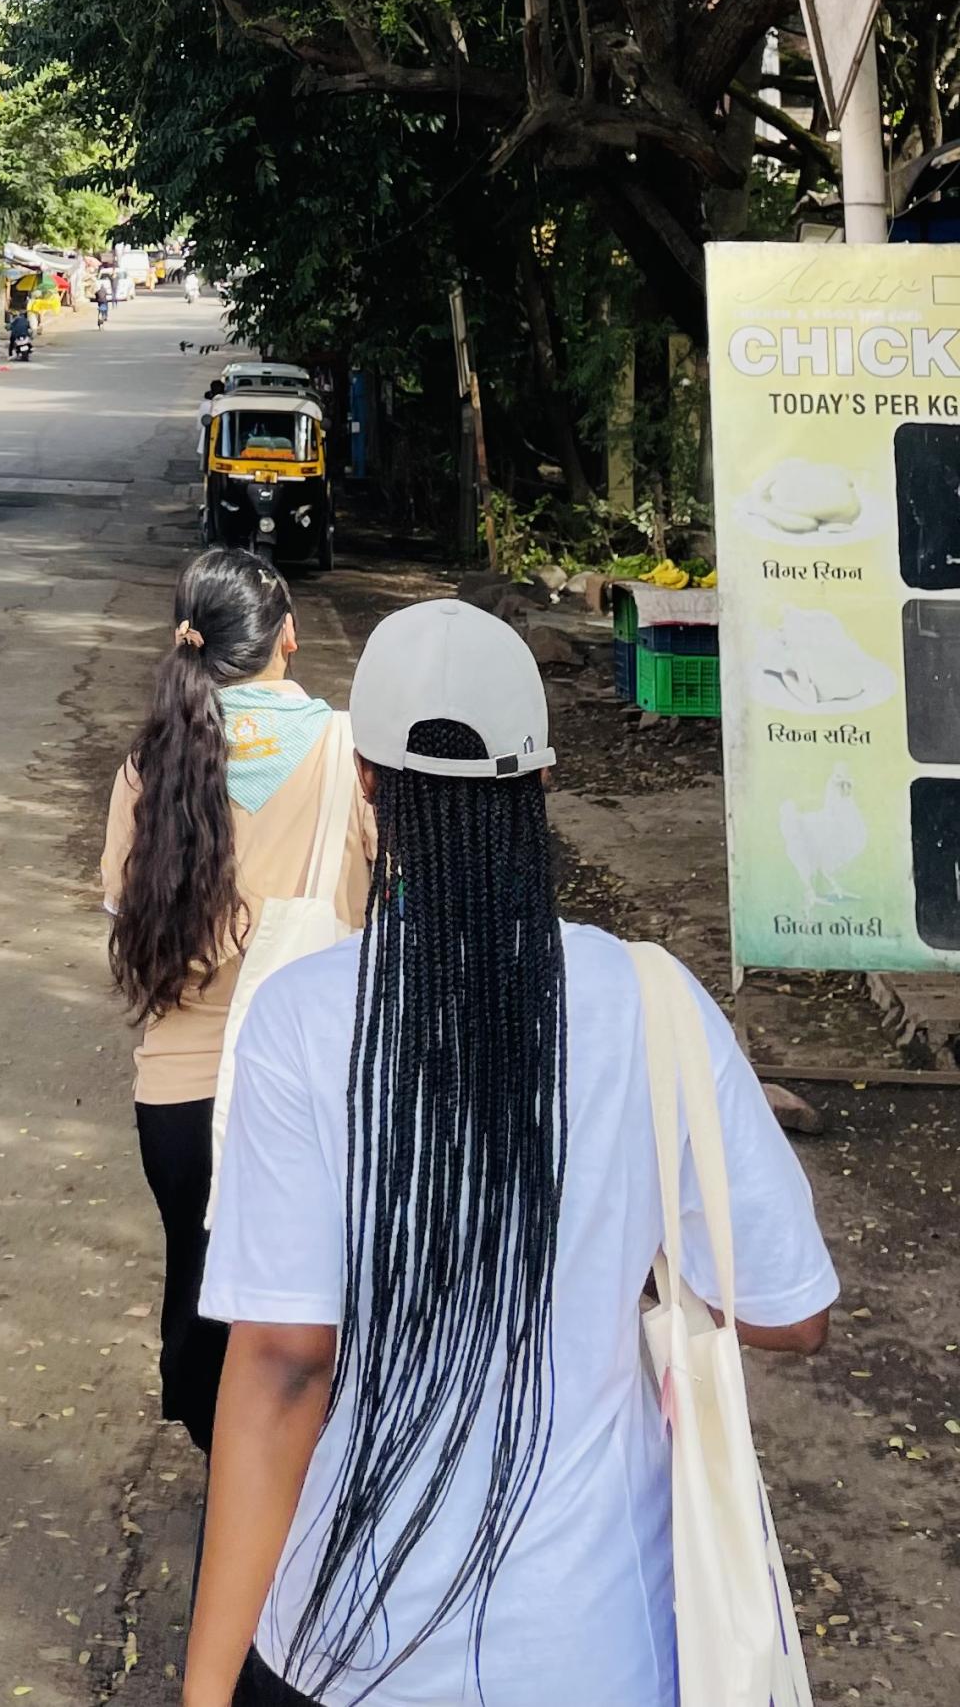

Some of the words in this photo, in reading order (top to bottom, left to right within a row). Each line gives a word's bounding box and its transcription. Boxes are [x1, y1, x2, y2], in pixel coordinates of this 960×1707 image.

[728, 325, 960, 378] CHICK
[769, 393, 866, 415] TODAY'S
[875, 394, 919, 415] PER
[928, 395, 958, 416] KG
